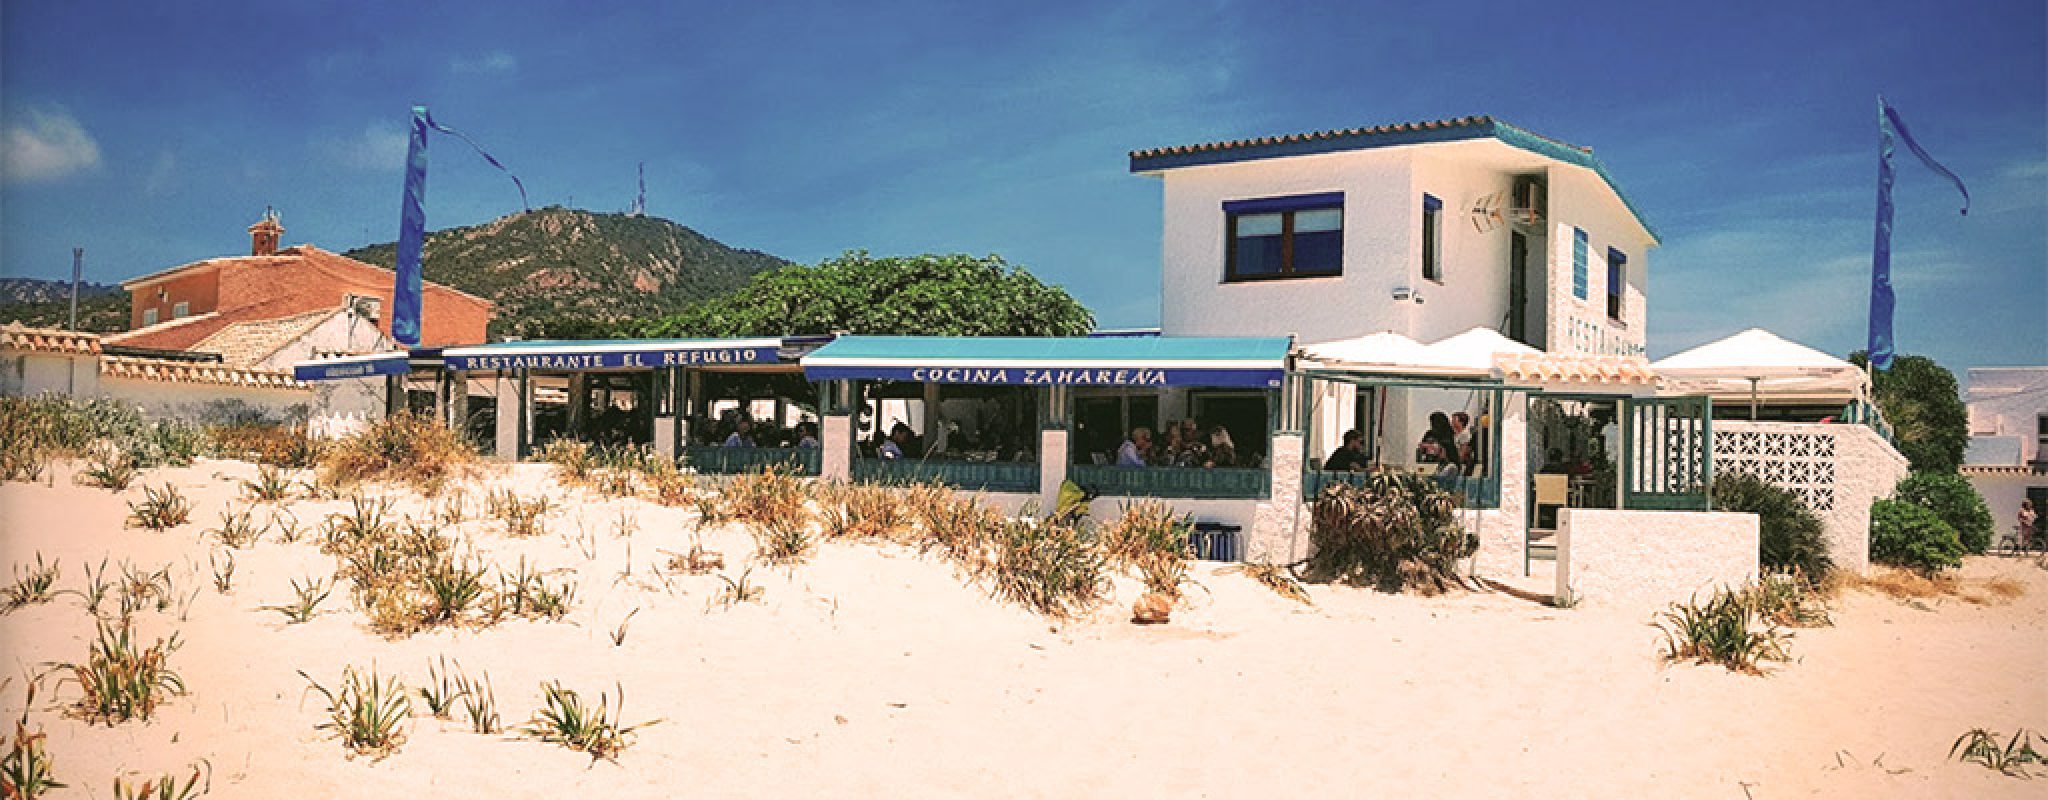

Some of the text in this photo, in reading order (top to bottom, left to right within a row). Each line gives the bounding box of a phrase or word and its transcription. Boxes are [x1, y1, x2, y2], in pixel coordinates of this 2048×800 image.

[467, 355, 604, 369] RESTAURANTE
[623, 352, 643, 367] EL
[663, 349, 758, 365] REFUGIO
[911, 368, 1009, 383] COCINA
